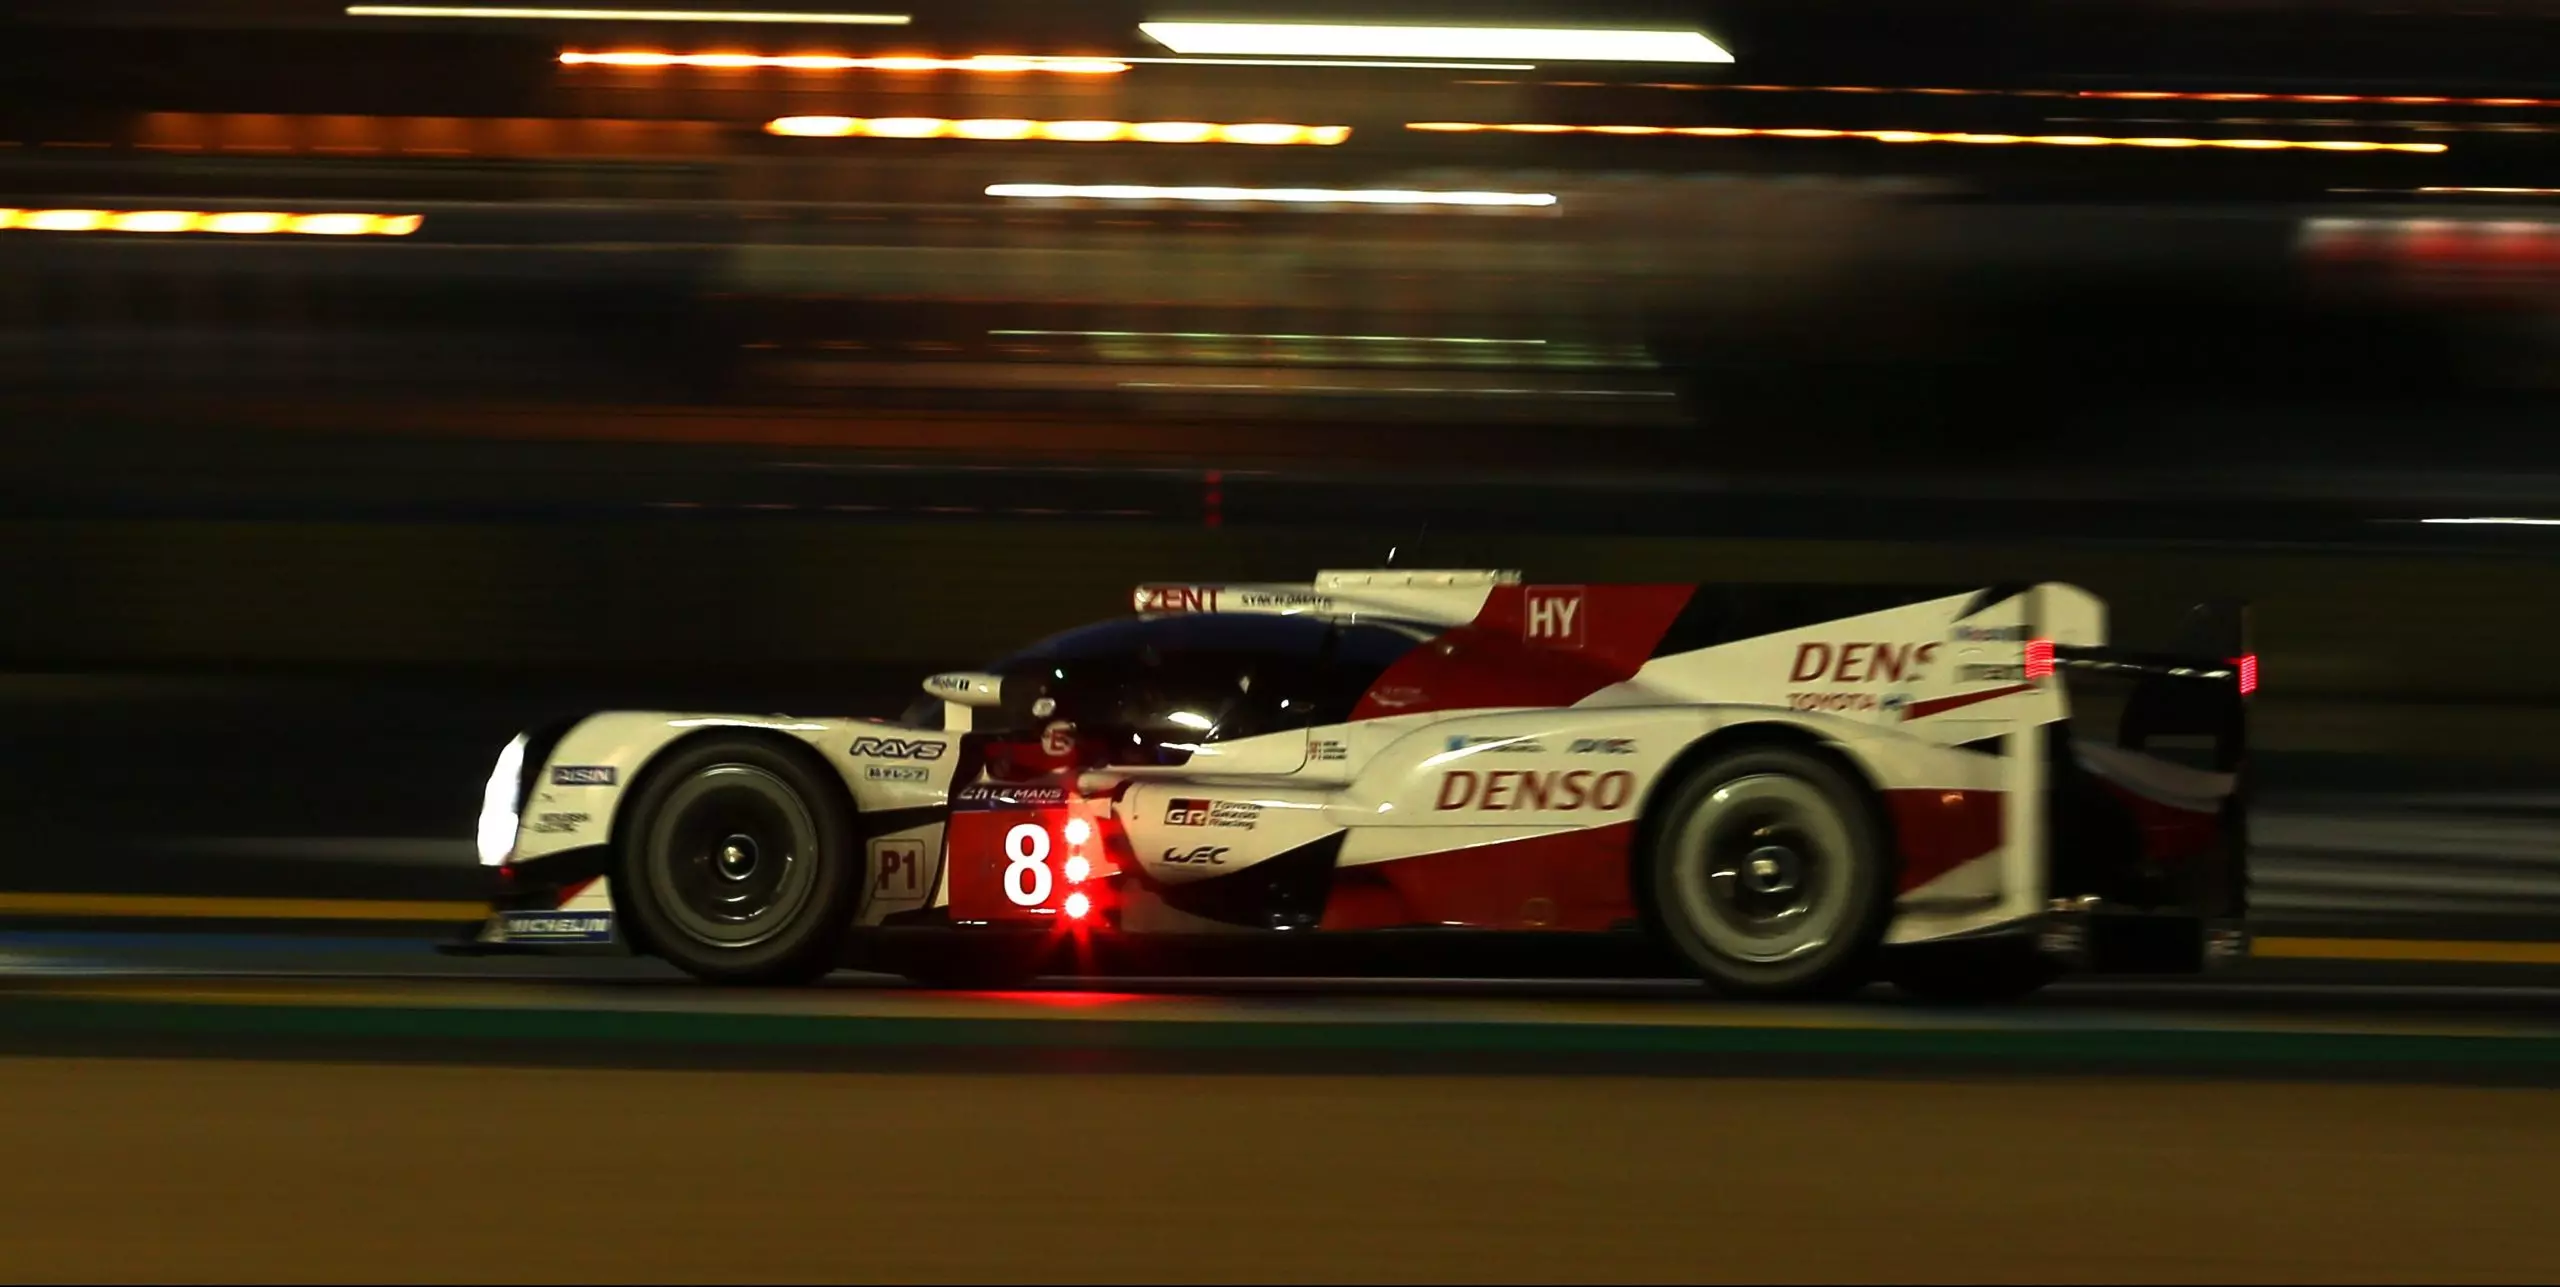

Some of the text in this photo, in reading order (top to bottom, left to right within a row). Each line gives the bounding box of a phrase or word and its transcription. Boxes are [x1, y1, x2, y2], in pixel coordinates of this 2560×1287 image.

[1140, 585, 1226, 613] ZENT
[1529, 597, 1579, 638] HY
[849, 736, 947, 760] RAYS
[1014, 788, 1061, 798] MANS
[1434, 770, 1636, 811] DENSO
[1166, 809, 1206, 824] GR
[1004, 823, 1053, 906] 8
[1163, 846, 1230, 865] WEC
[879, 850, 918, 890] P1
[506, 918, 608, 933] MICHELIN
